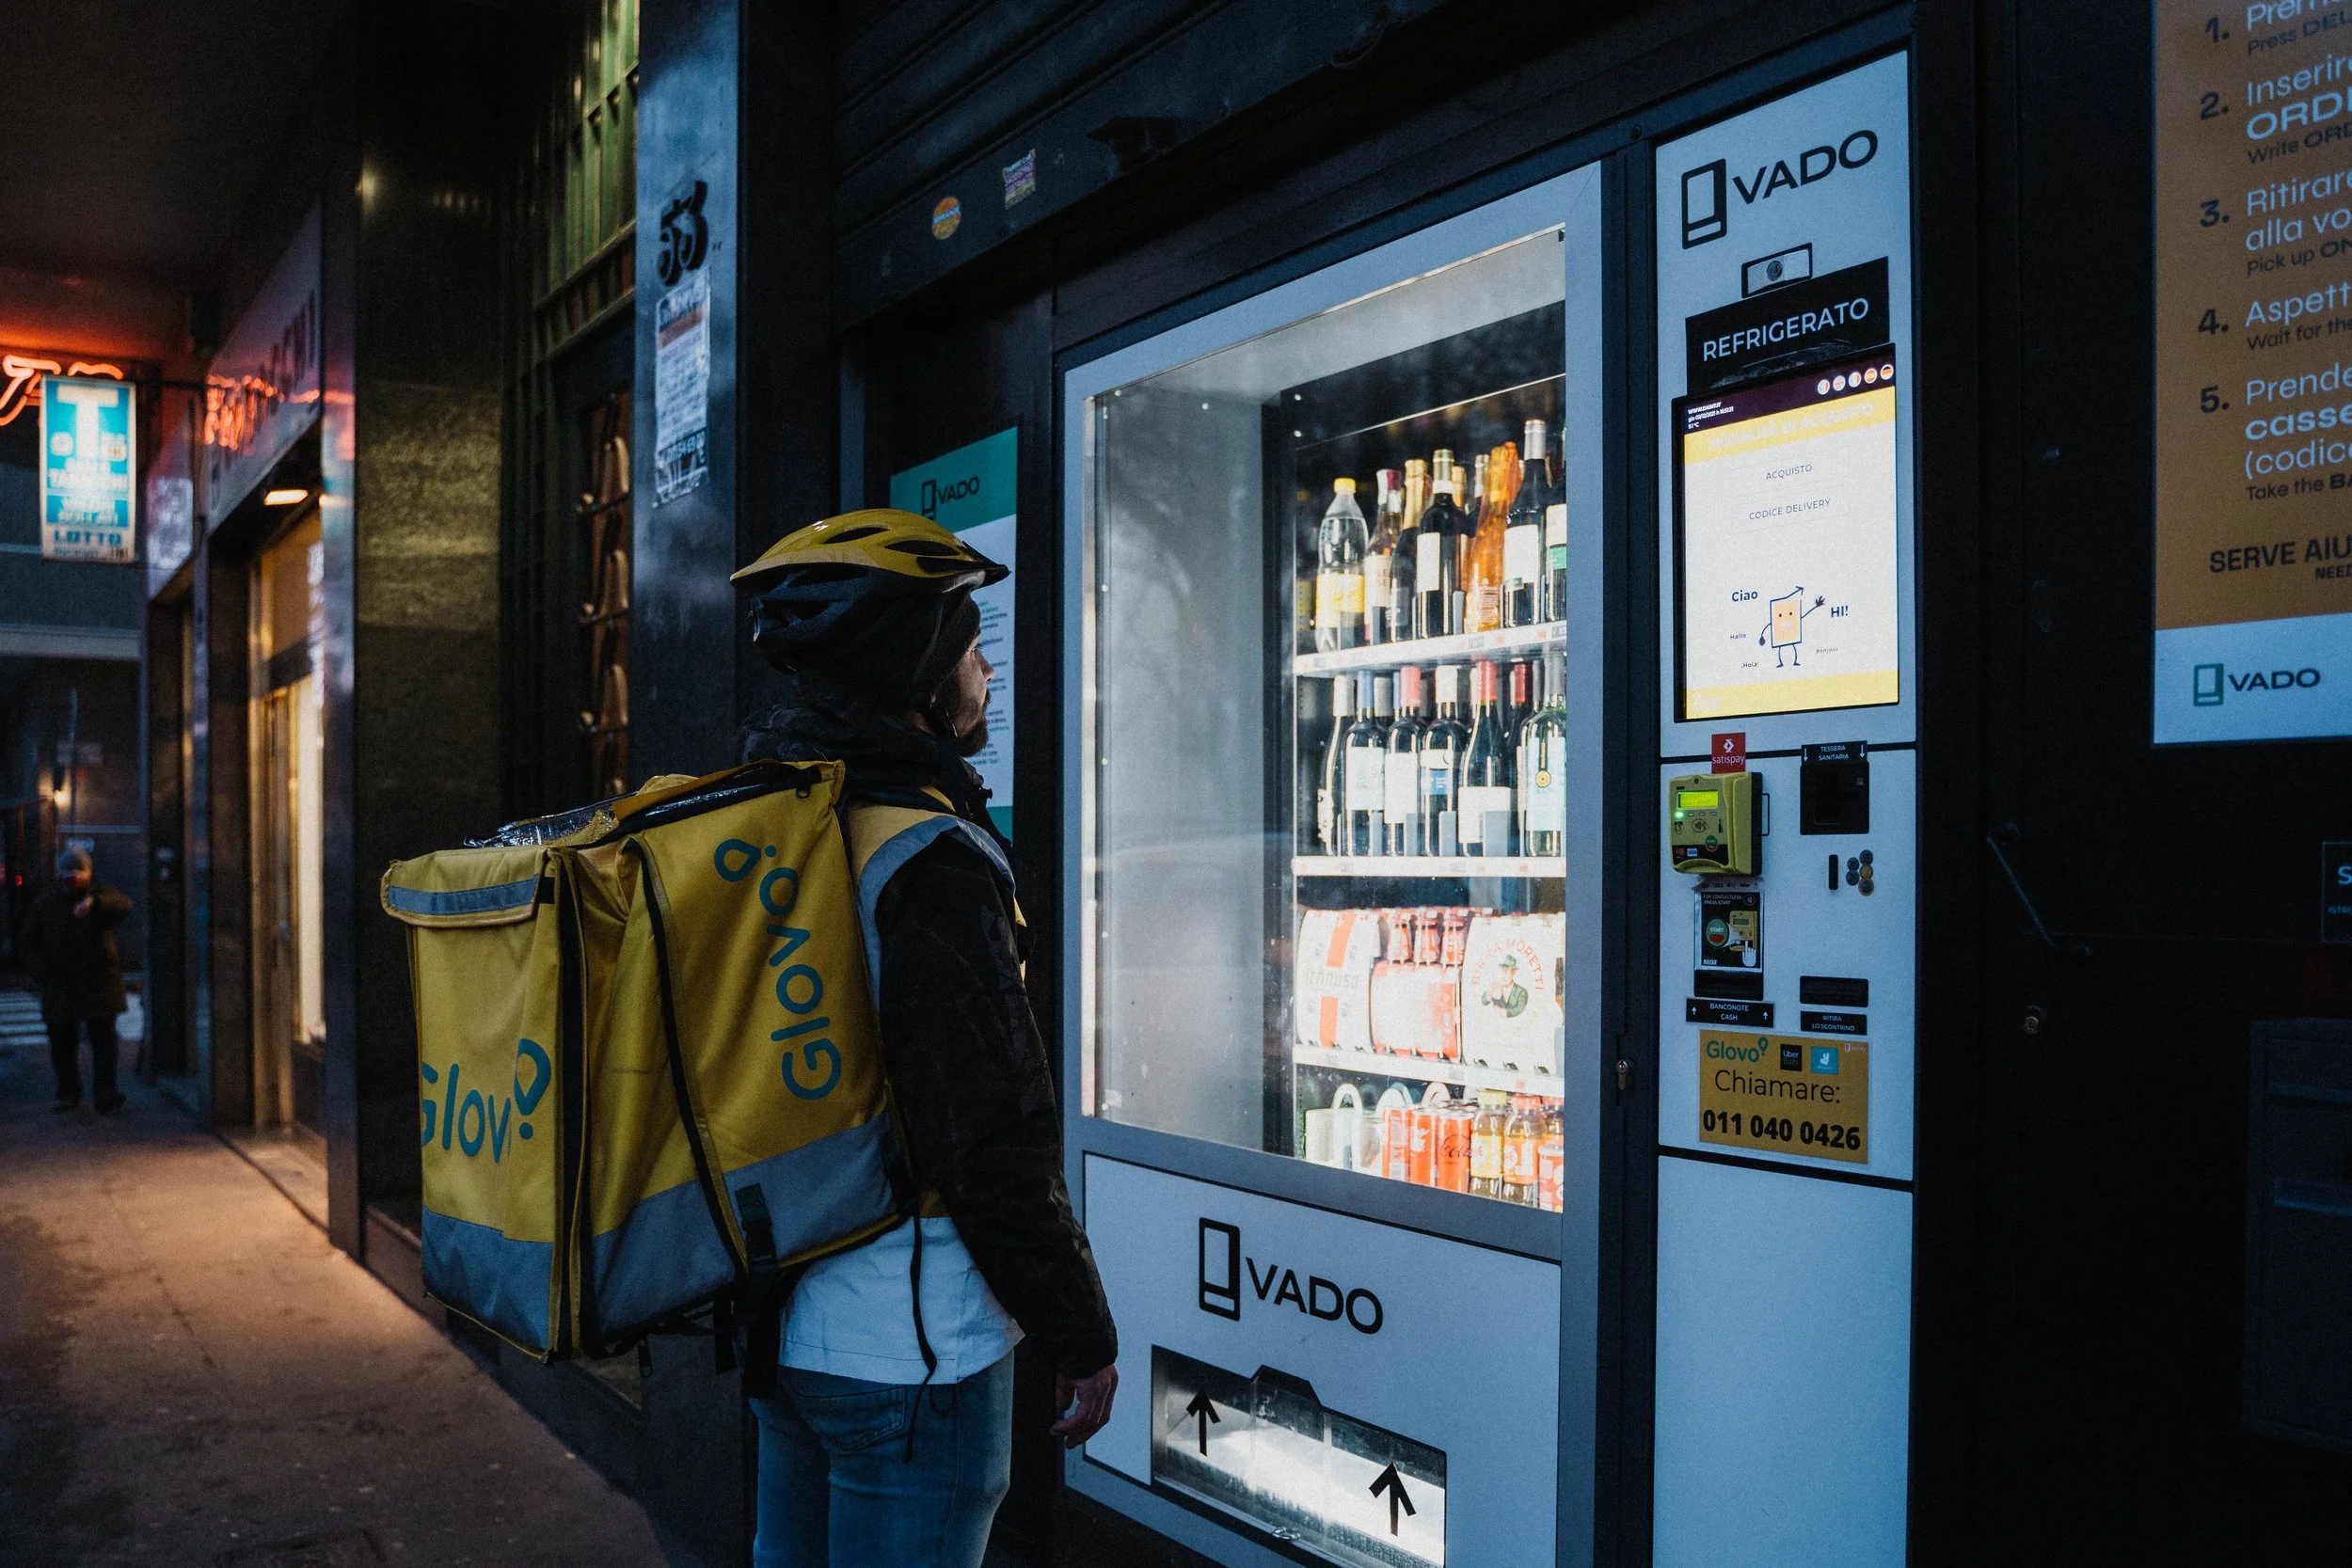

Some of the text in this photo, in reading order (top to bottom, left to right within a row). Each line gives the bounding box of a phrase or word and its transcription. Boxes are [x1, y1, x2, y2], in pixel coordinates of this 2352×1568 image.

[2204, 17, 2230, 42] 1.
[2201, 53, 2352, 120] 2. Inserir
[2247, 141, 2299, 165] Write
[1732, 129, 1879, 205] VADO
[2201, 198, 2230, 228] 3.
[2245, 216, 2304, 252] alla
[2247, 253, 2286, 277] Pick
[2291, 248, 2315, 266] up
[2198, 280, 2352, 335] 4. Aspett
[1703, 297, 1869, 362] REFRIGERATO
[2247, 329, 2291, 351] Wait
[2296, 325, 2323, 341] for
[2200, 385, 2230, 414] 5.
[1765, 464, 1813, 481] ACQUISTO
[2244, 437, 2352, 482] (codic
[938, 475, 980, 505] VADO
[2246, 483, 2289, 501] Take
[2293, 477, 2325, 494] the
[1749, 498, 1832, 520] CODICE DELIVERY
[2209, 541, 2296, 573] SERVE
[1731, 589, 1758, 603] Ciao
[2228, 668, 2321, 692] VADO
[1711, 753, 1745, 766] satispay
[1818, 752, 1850, 761] SANITARIA
[1820, 744, 1847, 752] TESSERA
[758, 866, 842, 1101] Glovo
[1709, 1003, 1750, 1012] BANCONOTE
[1720, 1013, 1739, 1022] CASH
[1822, 1014, 1843, 1022] RITIRA
[1820, 1023, 1856, 1032] SCONTRINO
[1706, 1038, 1760, 1063] Glovo
[1782, 1049, 1800, 1059] Uber
[1714, 1069, 1841, 1104] Chiamare:
[1703, 1109, 1861, 1150] 011 040 0426
[1245, 1256, 1384, 1335] VADO
